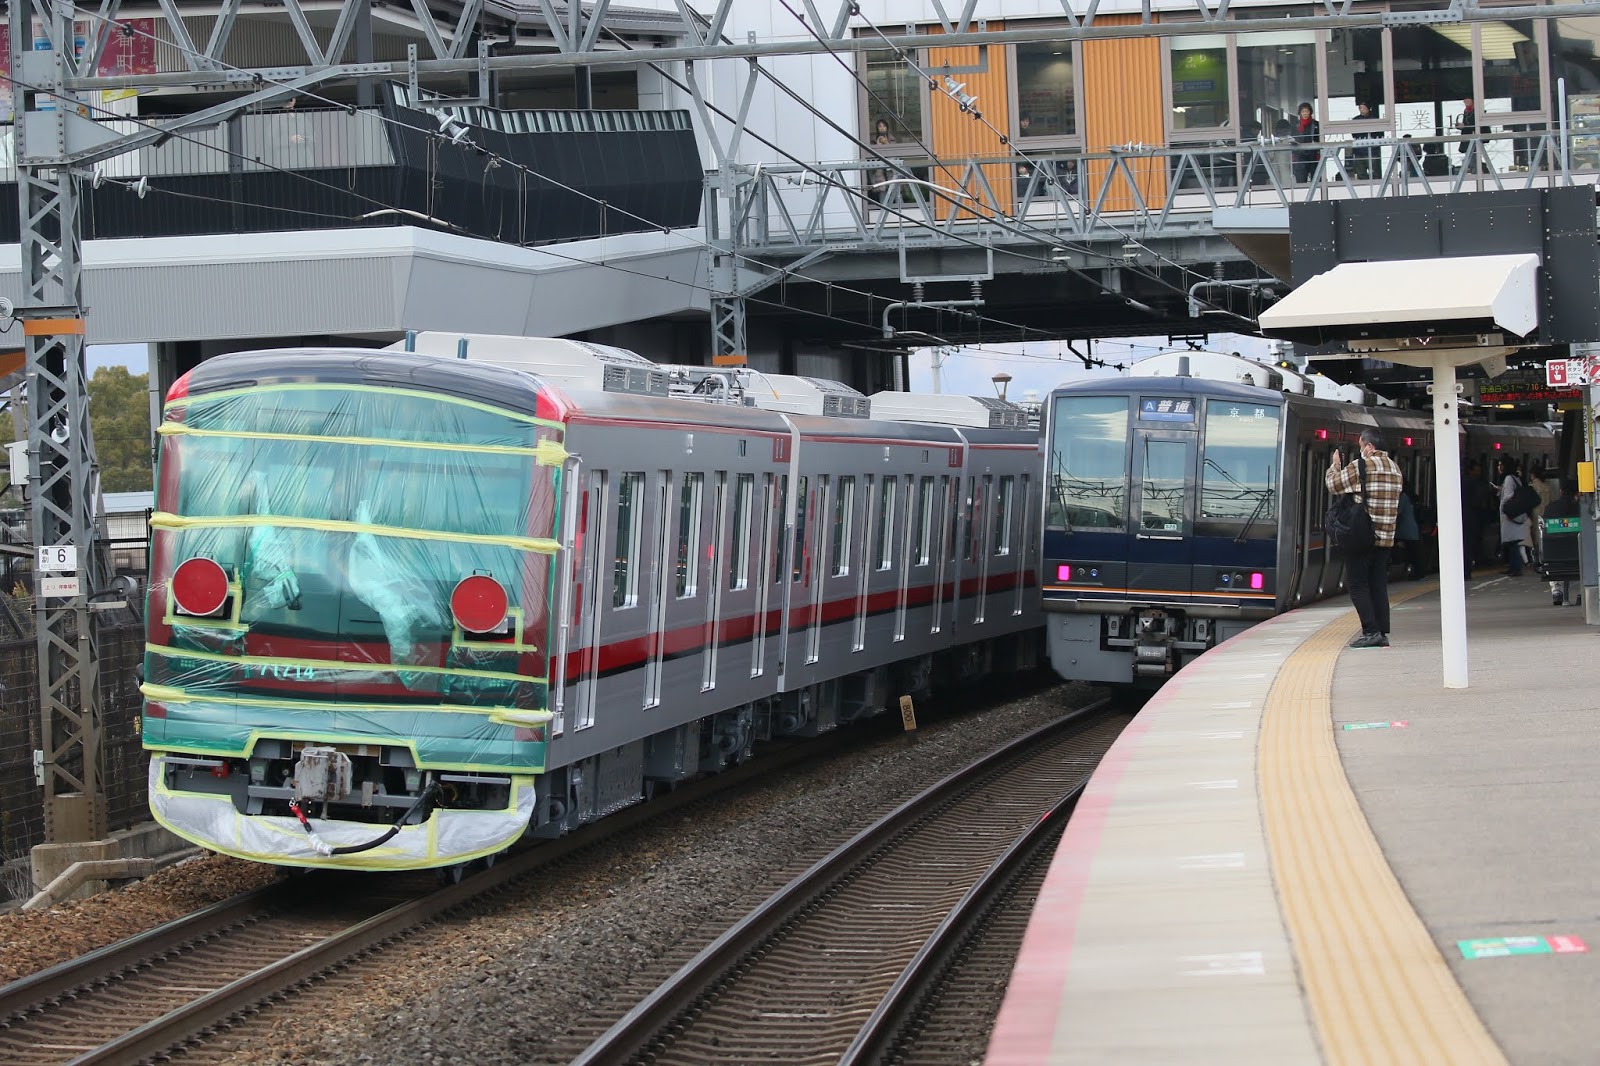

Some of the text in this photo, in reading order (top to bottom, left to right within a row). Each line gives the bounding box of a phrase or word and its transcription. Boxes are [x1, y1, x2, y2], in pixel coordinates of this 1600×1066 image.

[1145, 401, 1154, 410] A
[1157, 399, 1192, 413] 普通
[1228, 407, 1265, 419] 京都
[57, 548, 66, 563] 6
[902, 704, 913, 722] 800
